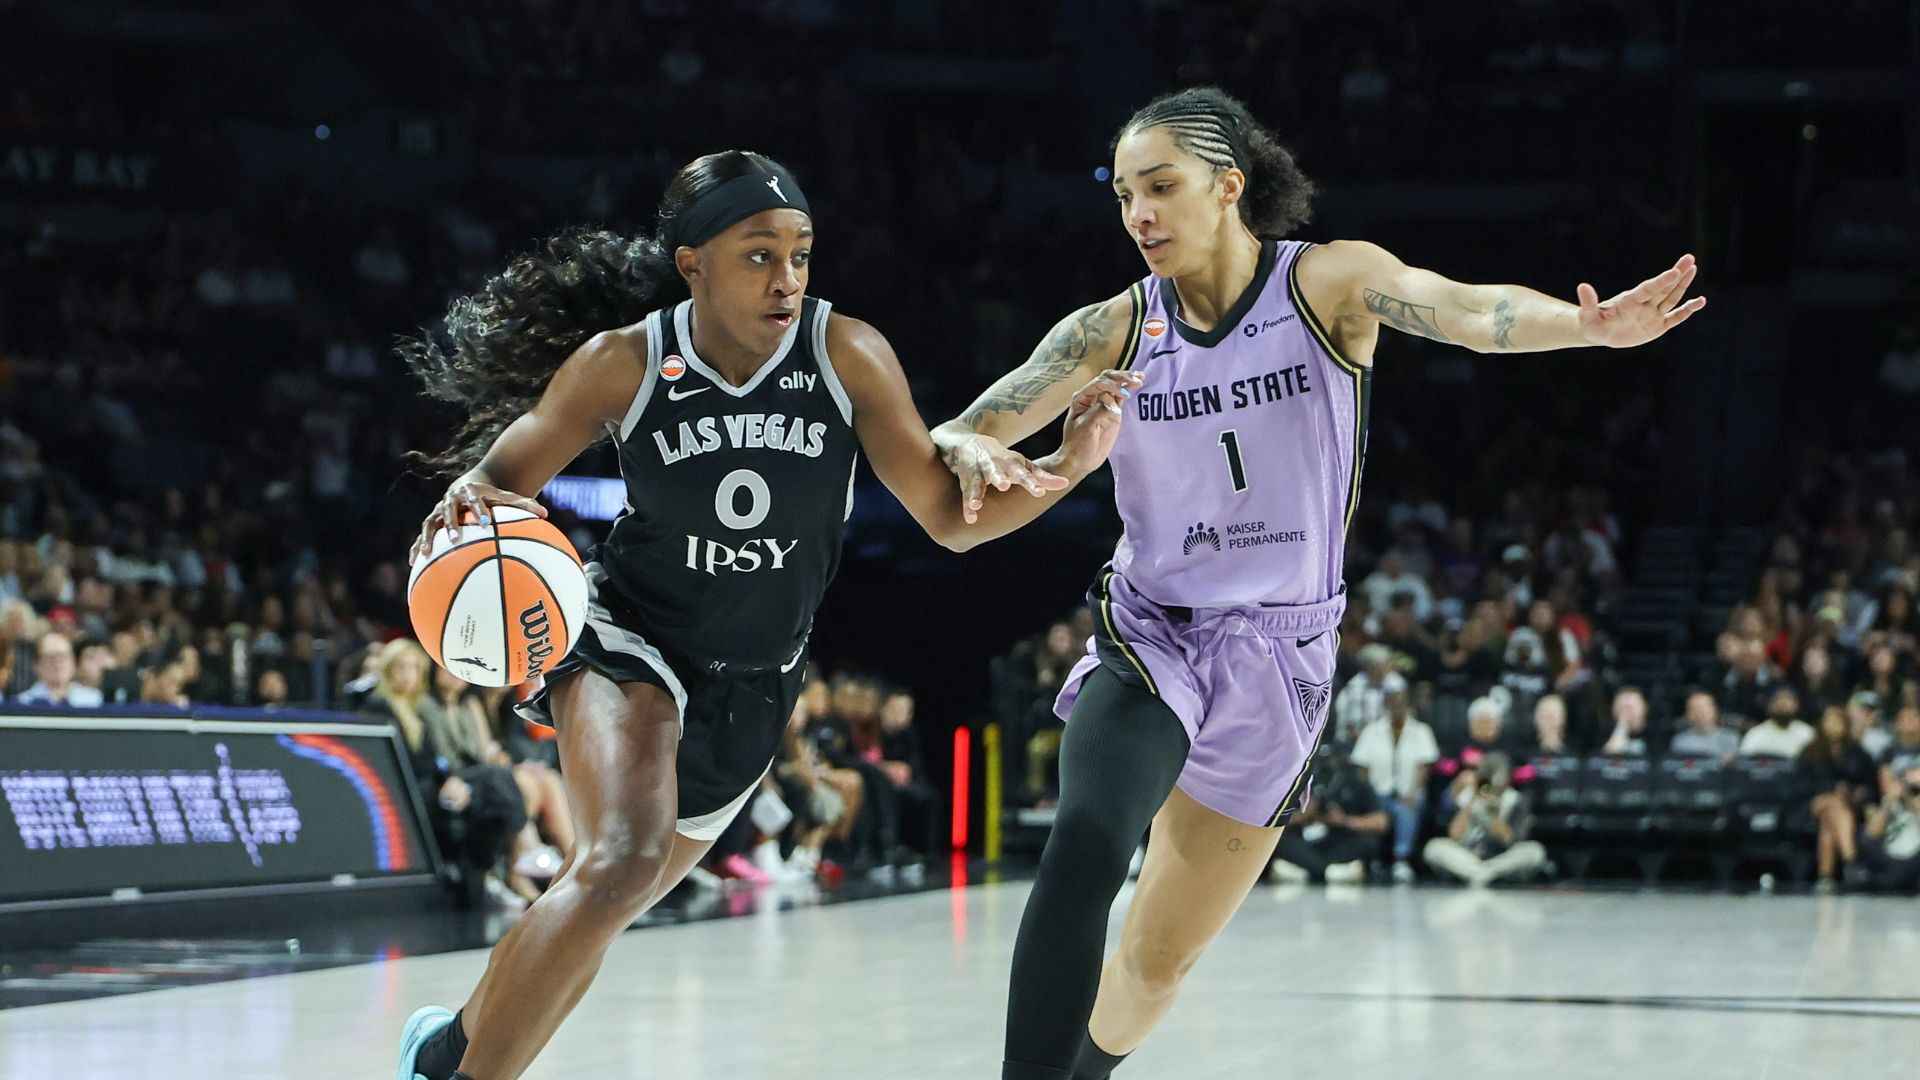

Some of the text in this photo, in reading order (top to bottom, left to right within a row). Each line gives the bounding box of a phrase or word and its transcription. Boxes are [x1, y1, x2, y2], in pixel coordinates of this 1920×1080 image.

[0, 147, 63, 184] AY
[1261, 314, 1295, 333] freedom
[779, 371, 817, 393] ally
[1137, 363, 1311, 422] GOLDEN STATE
[651, 413, 828, 466] LAS VEGAS
[1217, 428, 1249, 495] 1
[714, 468, 772, 531] 0
[1226, 521, 1266, 536] KAISER
[1228, 530, 1307, 550] PERMANENTE
[685, 534, 799, 577] IPSY
[519, 598, 554, 680] Wilso
